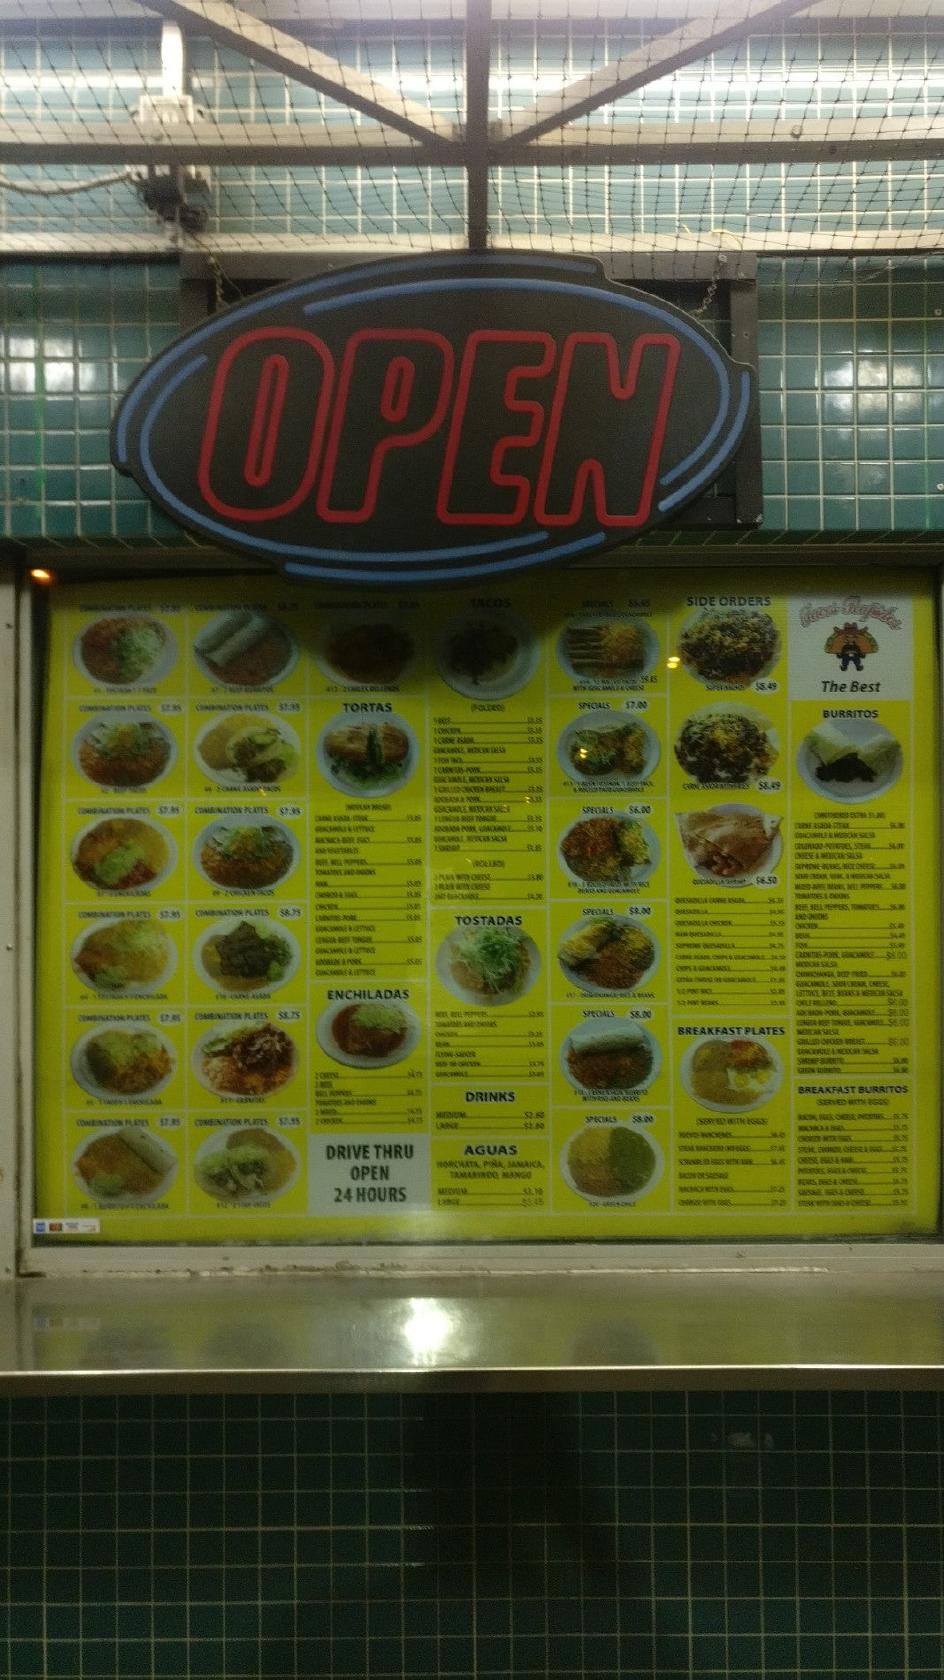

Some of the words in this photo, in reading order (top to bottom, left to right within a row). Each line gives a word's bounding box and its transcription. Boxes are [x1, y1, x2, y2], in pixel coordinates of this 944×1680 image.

[199, 326, 681, 528] OPEN
[471, 599, 511, 609] TACOS
[687, 597, 716, 607] SIDE
[719, 597, 771, 607] ORDERS
[821, 681, 847, 693] The
[850, 681, 881, 693] Best
[343, 703, 392, 713] TORTAS
[823, 710, 879, 719] BURRITOS
[454, 916, 522, 926] TOSTADAS
[327, 989, 409, 1000] ENCHILADAS
[677, 1027, 743, 1036] BREAKFAST
[745, 1027, 785, 1036] PLATES
[798, 1085, 857, 1094] BREAKFAST
[858, 1085, 909, 1094] BURRITOS
[465, 1091, 515, 1102] DRINKS
[326, 1145, 370, 1159] DRIVE
[373, 1145, 414, 1159] THRU
[464, 1145, 518, 1156] AGUAS
[350, 1165, 389, 1180] OPEN
[334, 1187, 351, 1202] 24
[356, 1187, 407, 1202] HOURS
